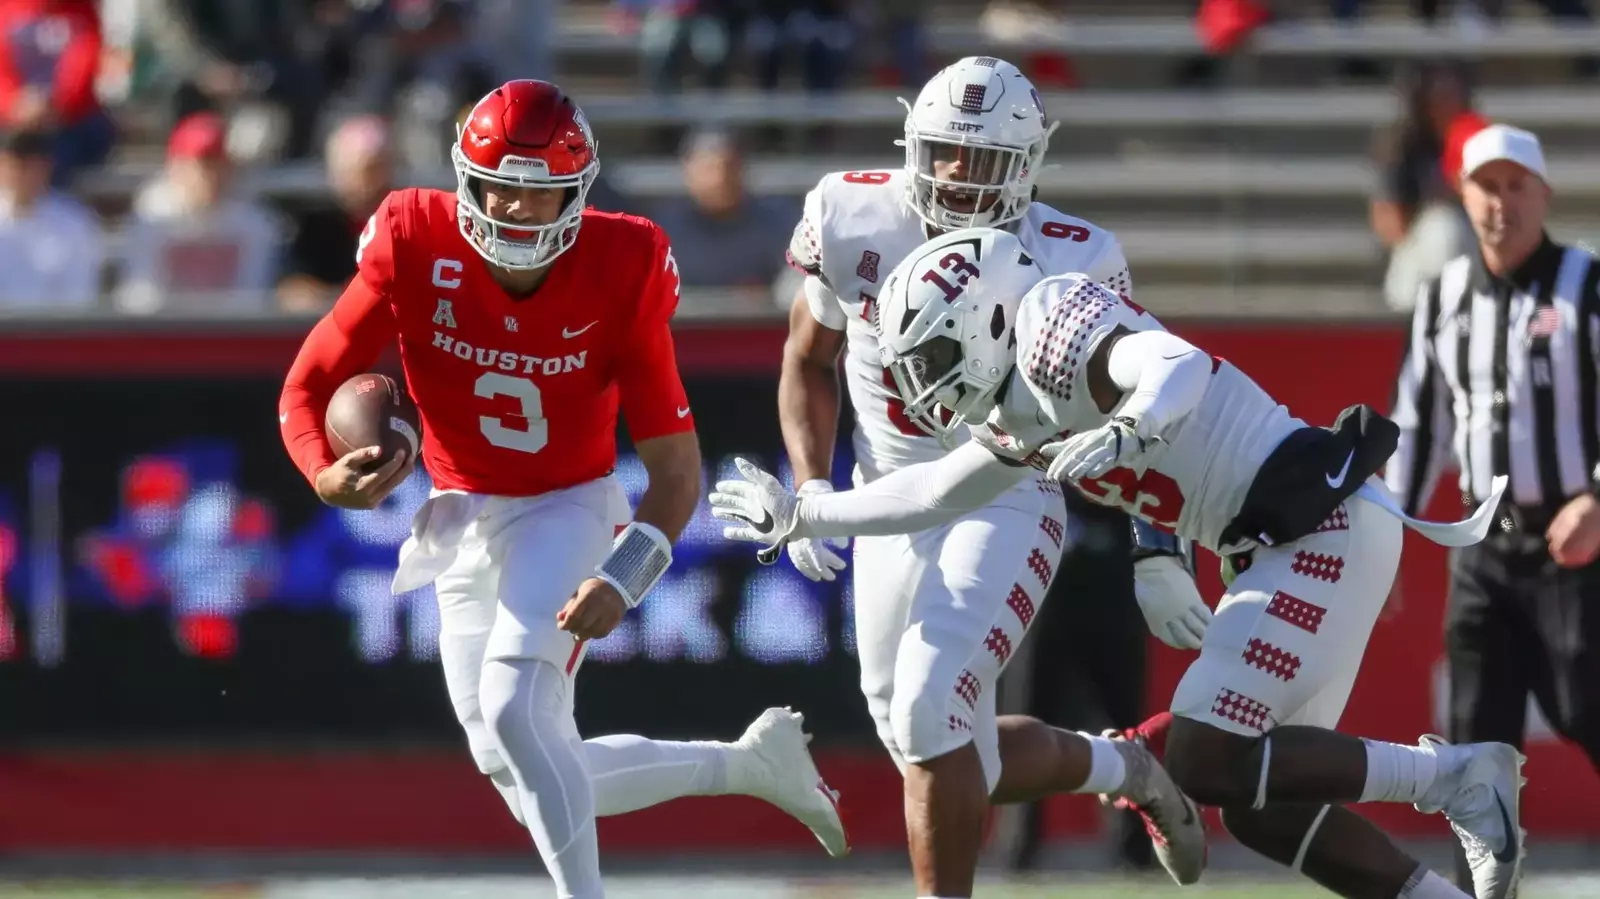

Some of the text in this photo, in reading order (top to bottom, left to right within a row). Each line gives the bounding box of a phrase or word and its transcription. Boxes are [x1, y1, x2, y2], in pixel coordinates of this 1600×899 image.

[950, 121, 984, 133] TUFF
[506, 159, 544, 168] HOUSTON
[945, 212, 970, 222] Riddell
[1041, 221, 1090, 242] 9
[432, 258, 463, 289] C
[920, 252, 980, 305] 13
[432, 331, 588, 376] HOUSTON
[474, 371, 548, 454] 3
